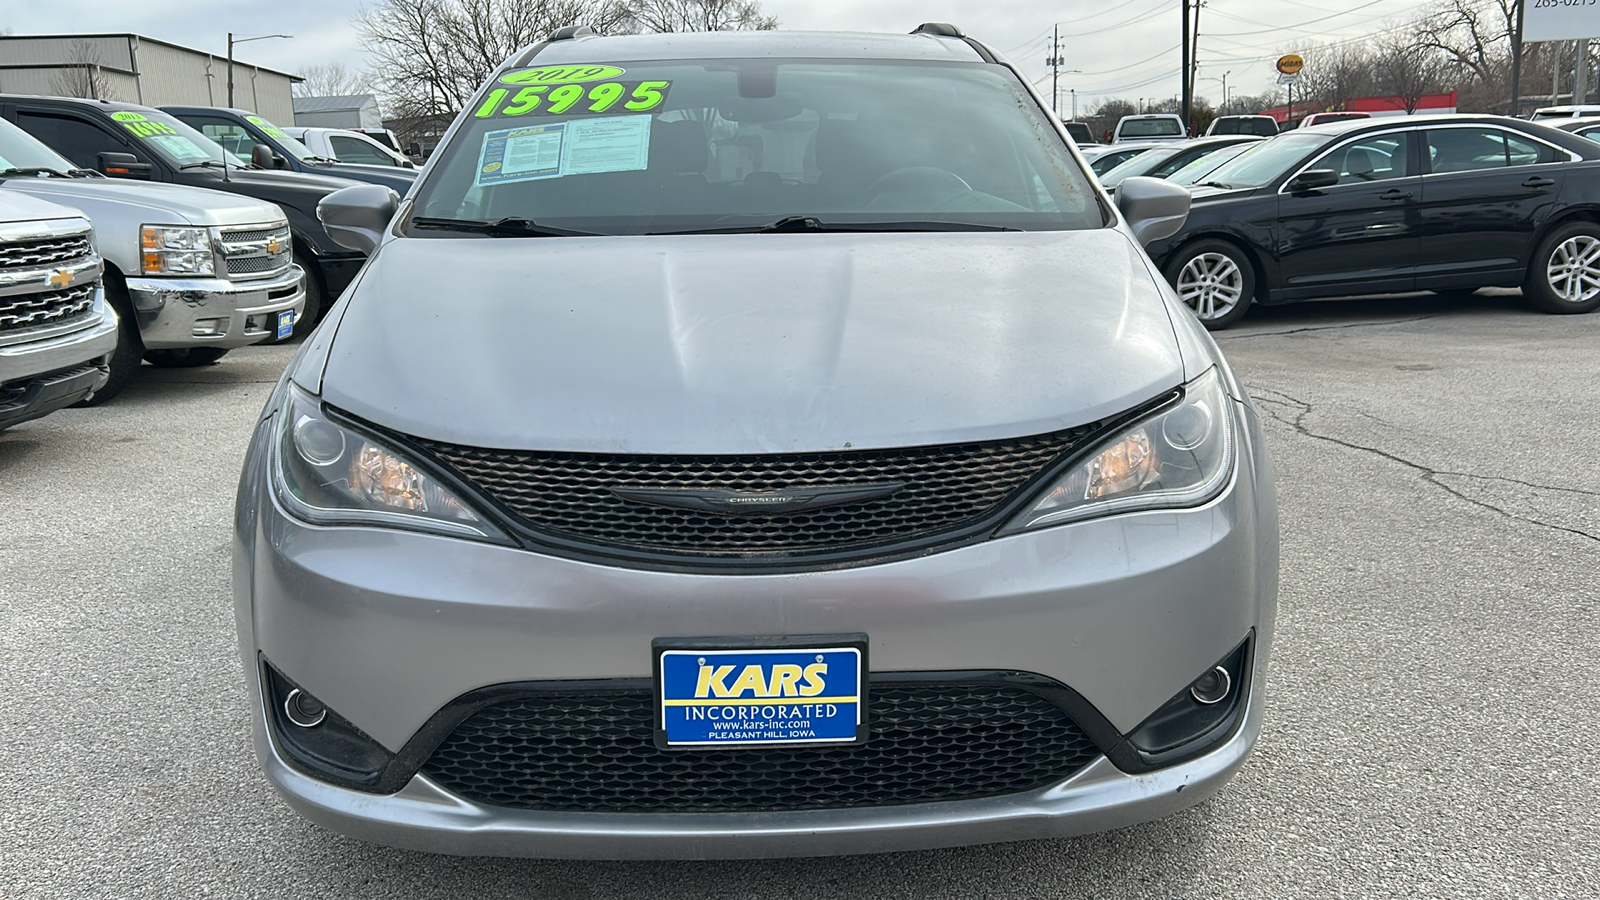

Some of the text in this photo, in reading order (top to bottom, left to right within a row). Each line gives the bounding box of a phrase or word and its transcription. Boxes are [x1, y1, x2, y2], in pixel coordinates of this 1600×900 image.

[516, 67, 605, 83] 2019
[474, 81, 669, 118] 15995
[123, 121, 178, 138] 16995
[694, 663, 828, 698] KARS
[685, 704, 838, 721] INCORPORATED
[713, 719, 811, 731] www.kars-inc.com
[708, 731, 762, 739] PLEASANT
[789, 730, 816, 738] IOWA
